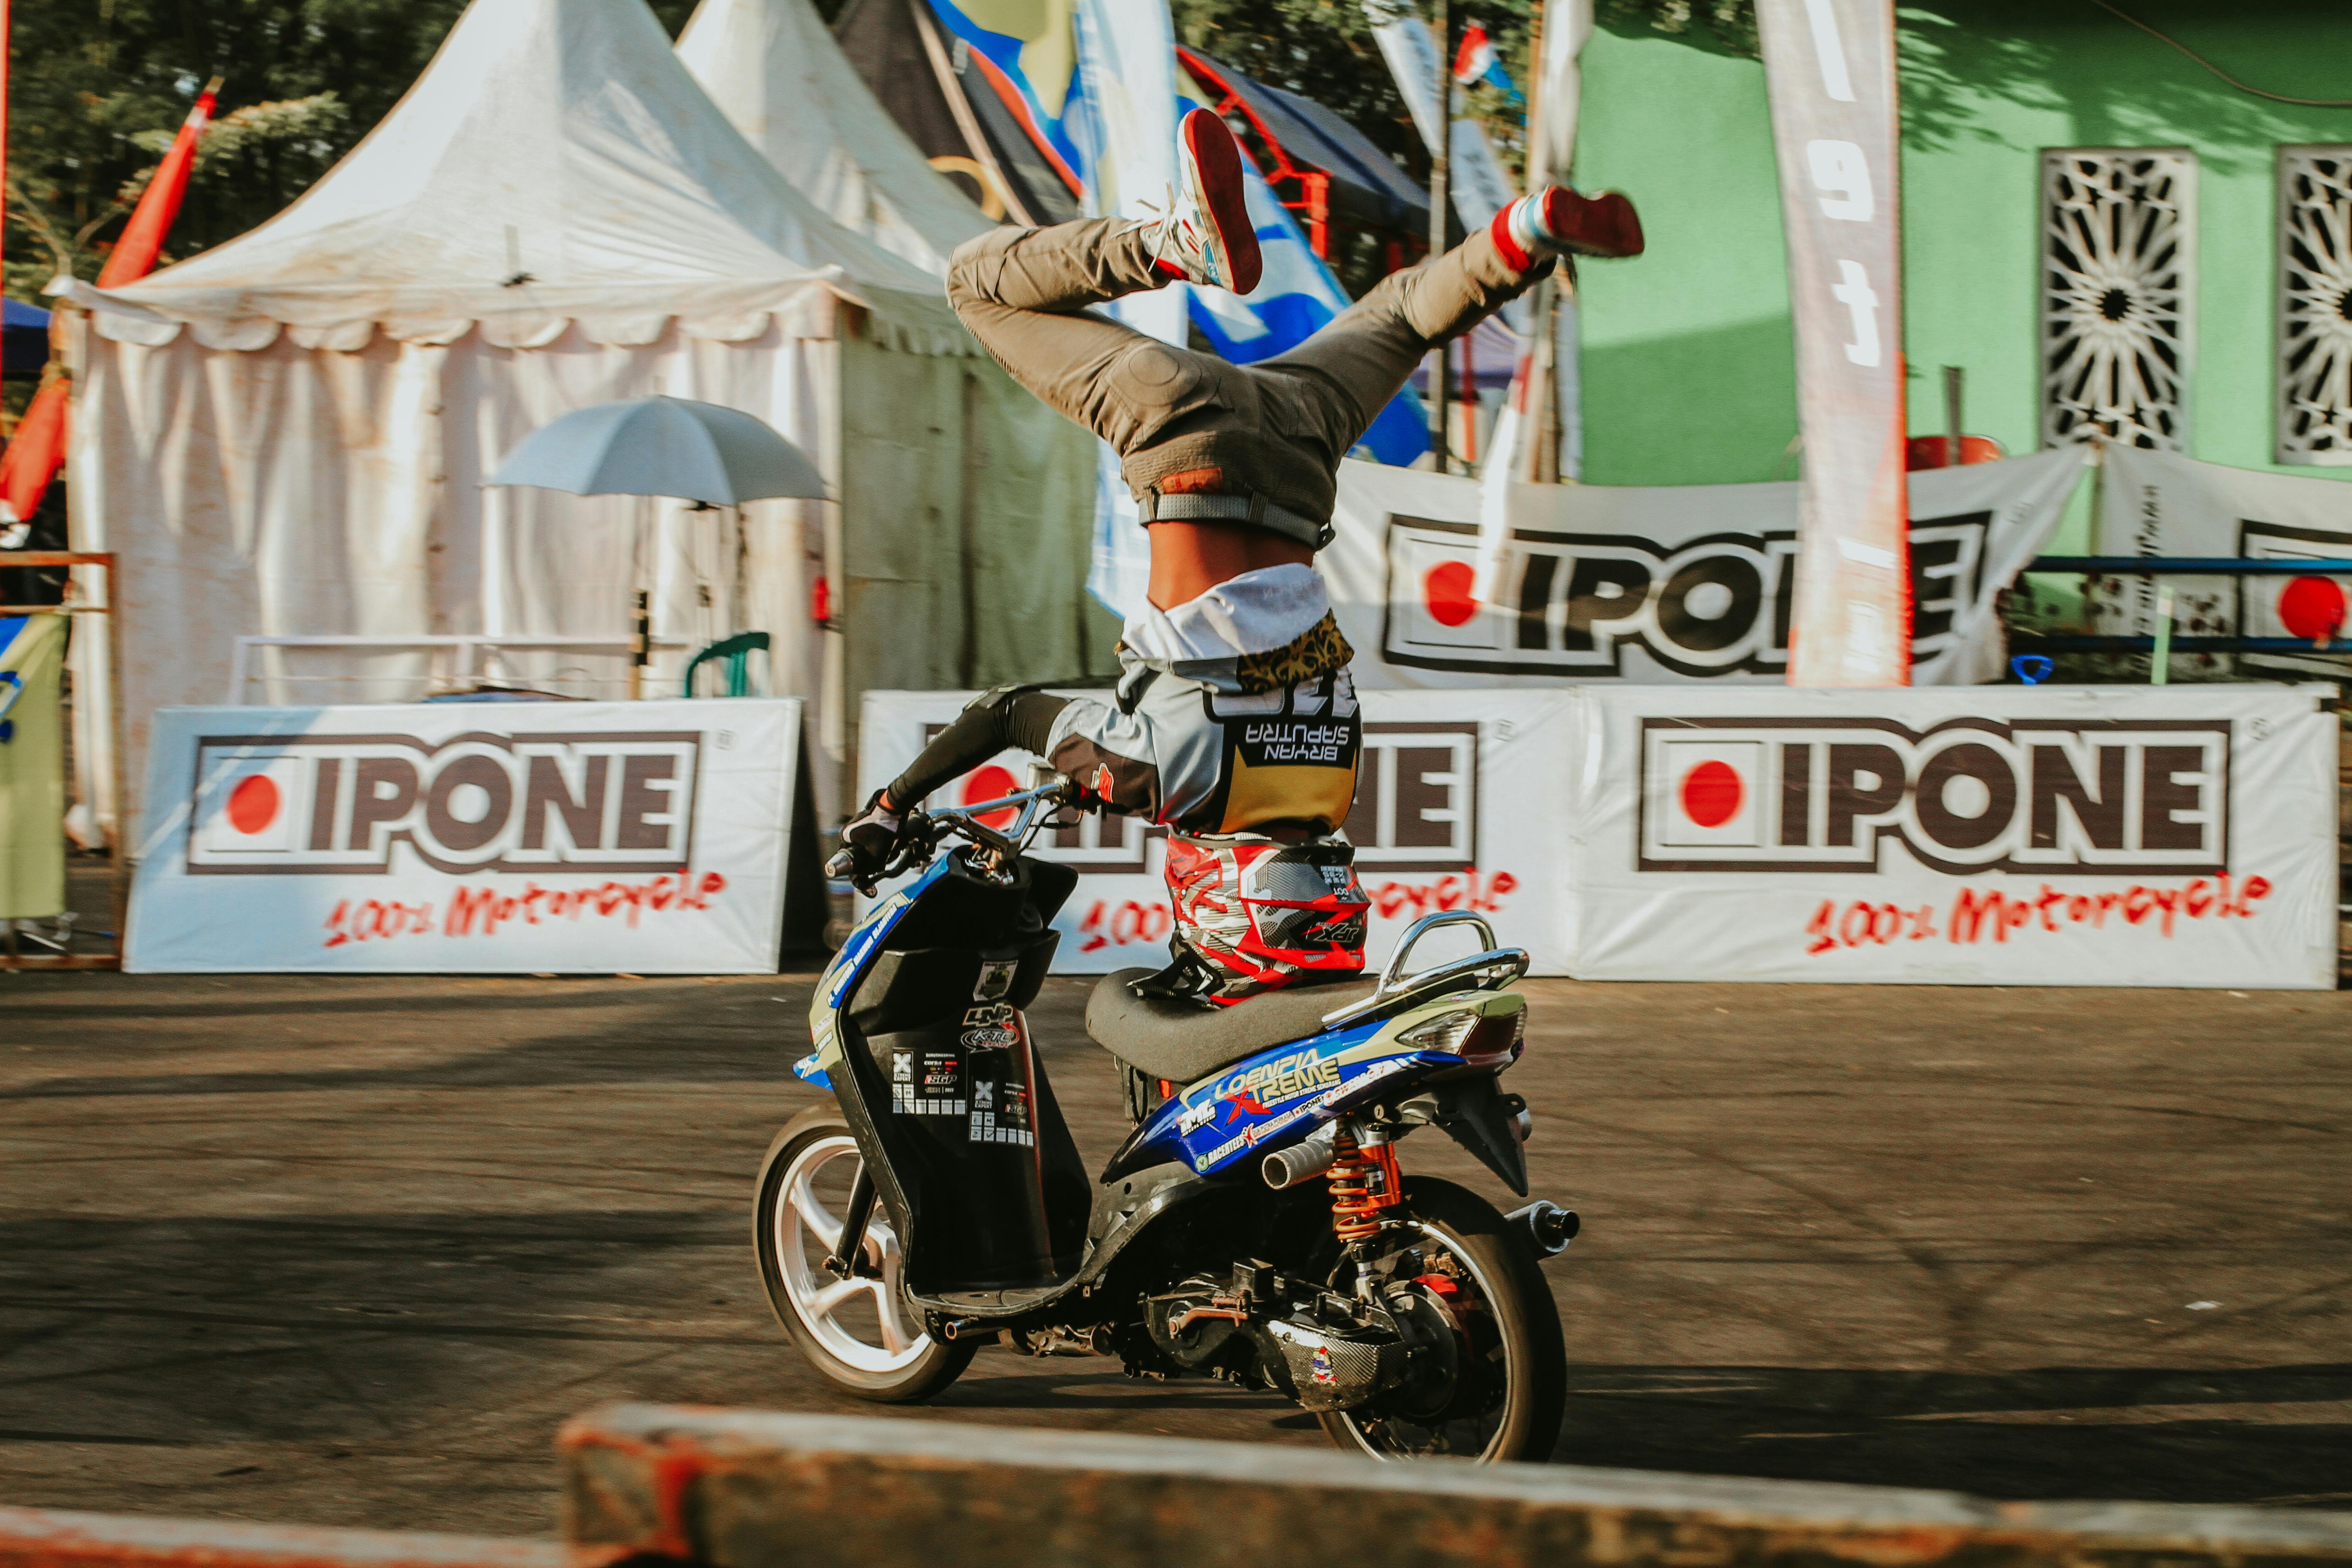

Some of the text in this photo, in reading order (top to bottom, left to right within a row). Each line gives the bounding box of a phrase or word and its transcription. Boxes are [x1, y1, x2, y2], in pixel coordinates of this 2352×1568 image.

[1518, 539, 1961, 652] IPOE
[1245, 723, 1350, 745] SAPUTRA
[1264, 744, 1338, 761] BRYAN
[309, 755, 676, 851] IPONE
[1780, 743, 2203, 849] IPONE
[444, 867, 727, 937] Motorcycle
[1079, 899, 1169, 954] 100
[1805, 869, 2273, 956] 100% Motorcycle
[1313, 922, 1359, 942] JPX
[974, 1030, 1011, 1043] KTC
[1215, 1048, 1318, 1100] LOENPIA
[1225, 1058, 1340, 1125] XTREME
[1262, 1095, 1284, 1108] FREESTYLE
[1317, 1078, 1341, 1090] SEMARANG
[1300, 1094, 1323, 1113] IPONE
[1208, 1137, 1245, 1165] RACERTEES
